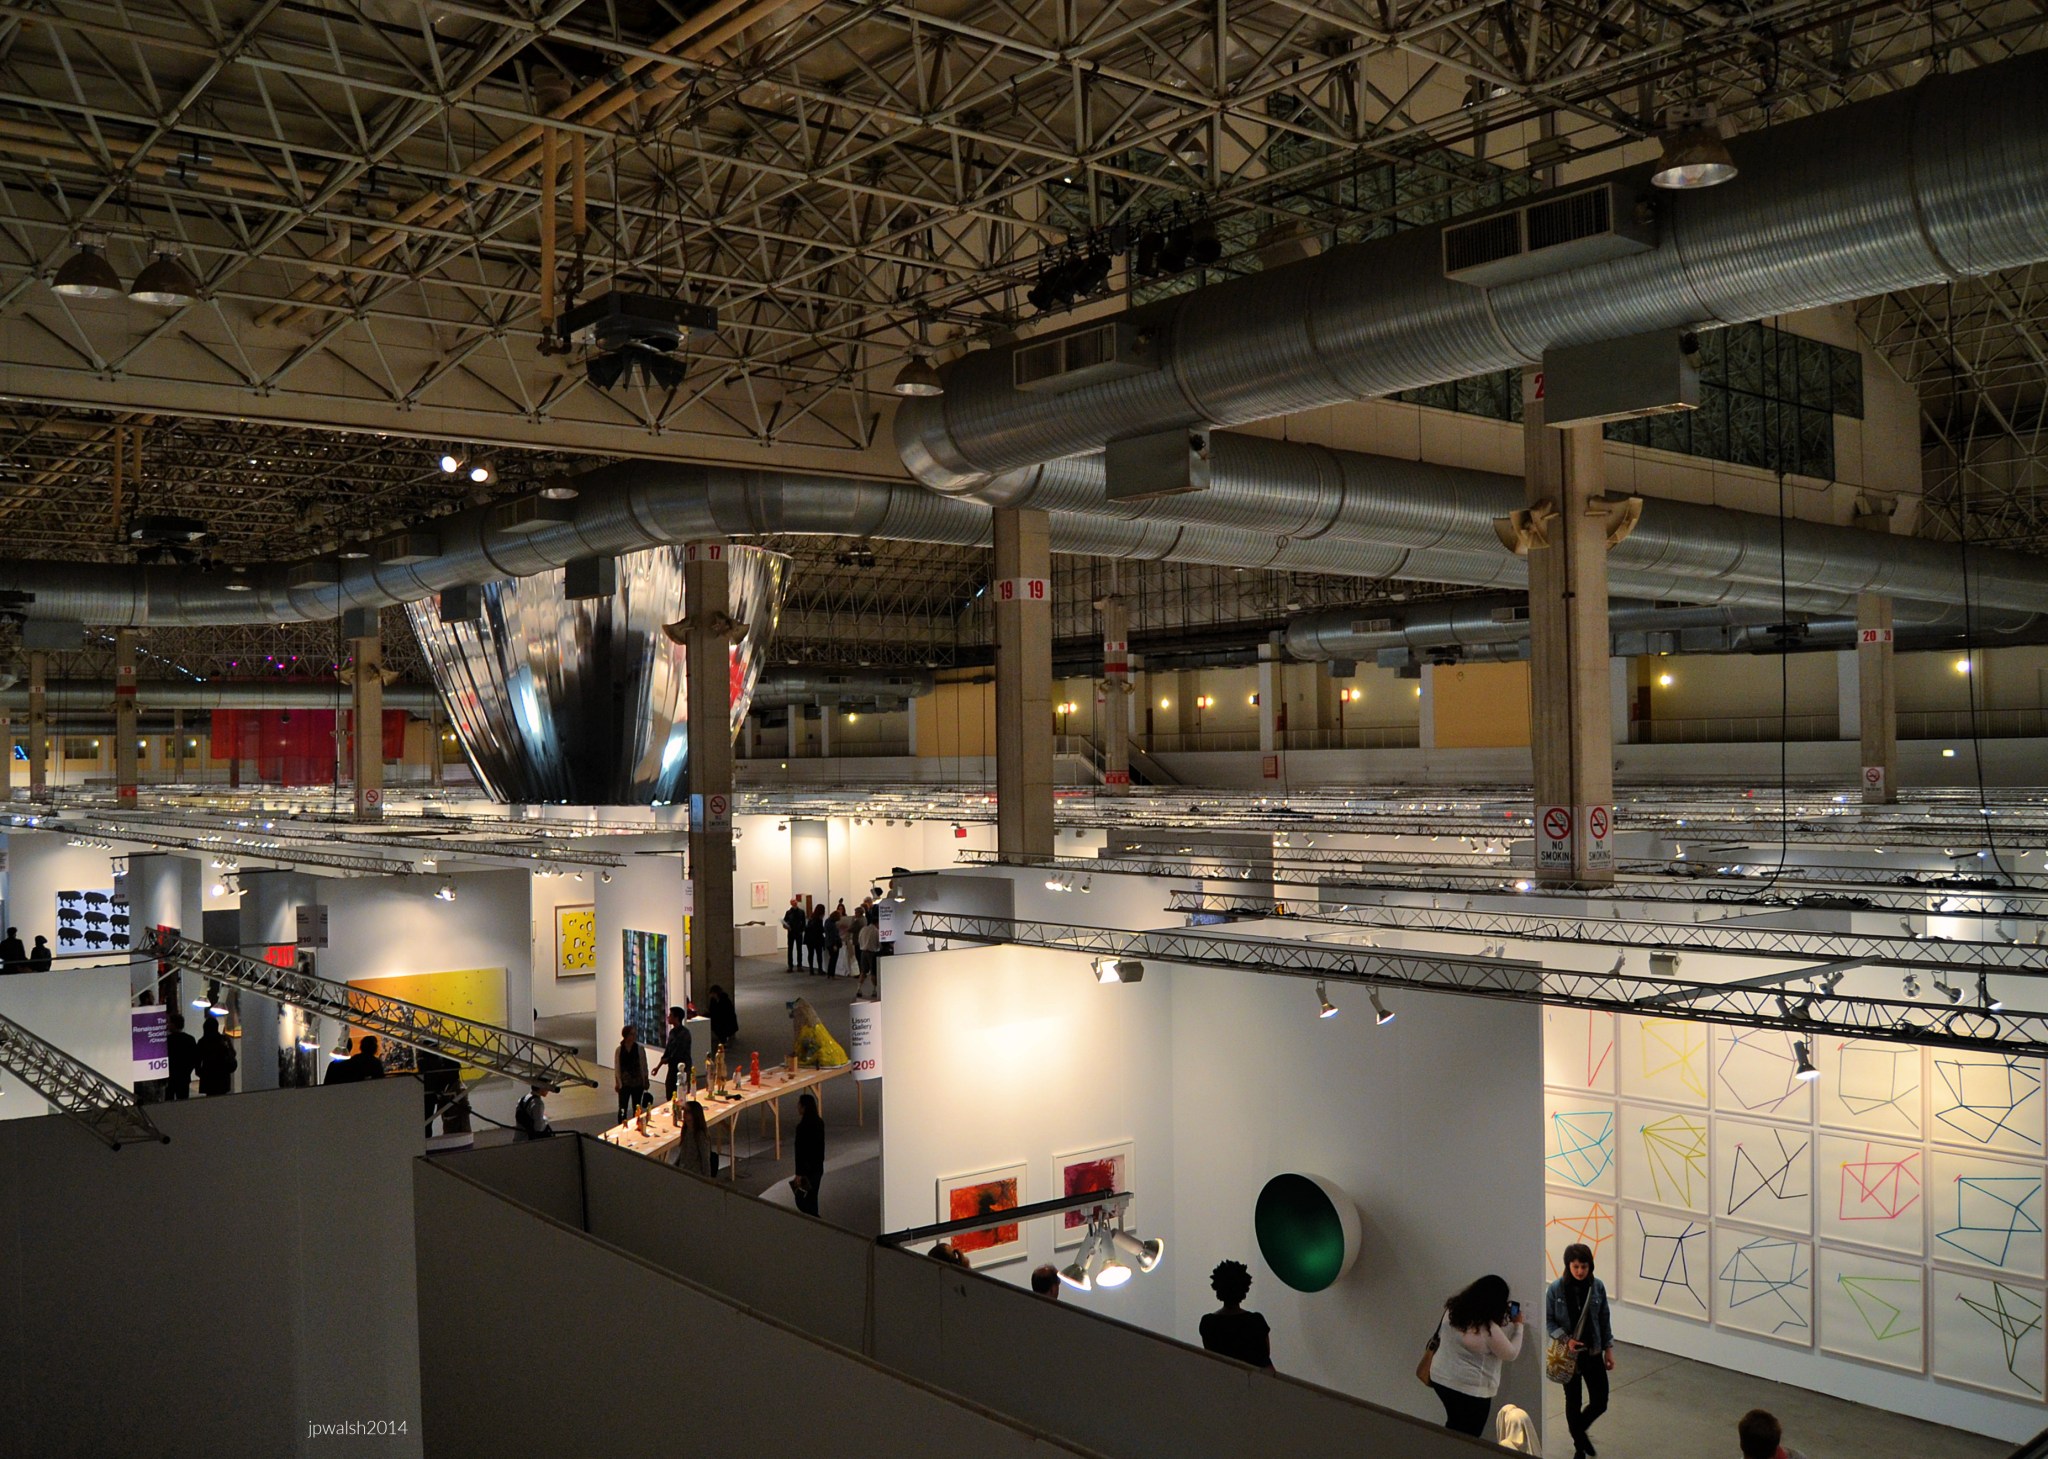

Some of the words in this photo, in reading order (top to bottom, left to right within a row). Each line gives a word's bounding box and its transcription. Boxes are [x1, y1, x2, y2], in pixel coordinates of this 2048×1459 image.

[709, 545, 721, 560] 17
[999, 580, 1013, 600] 19
[1027, 580, 1044, 599] 19
[1863, 630, 1877, 642] 20
[1552, 841, 1564, 850] NO
[1595, 841, 1604, 850] NO
[851, 1023, 873, 1031] Gallery
[148, 1059, 168, 1070] 106
[852, 1059, 876, 1071] 209
